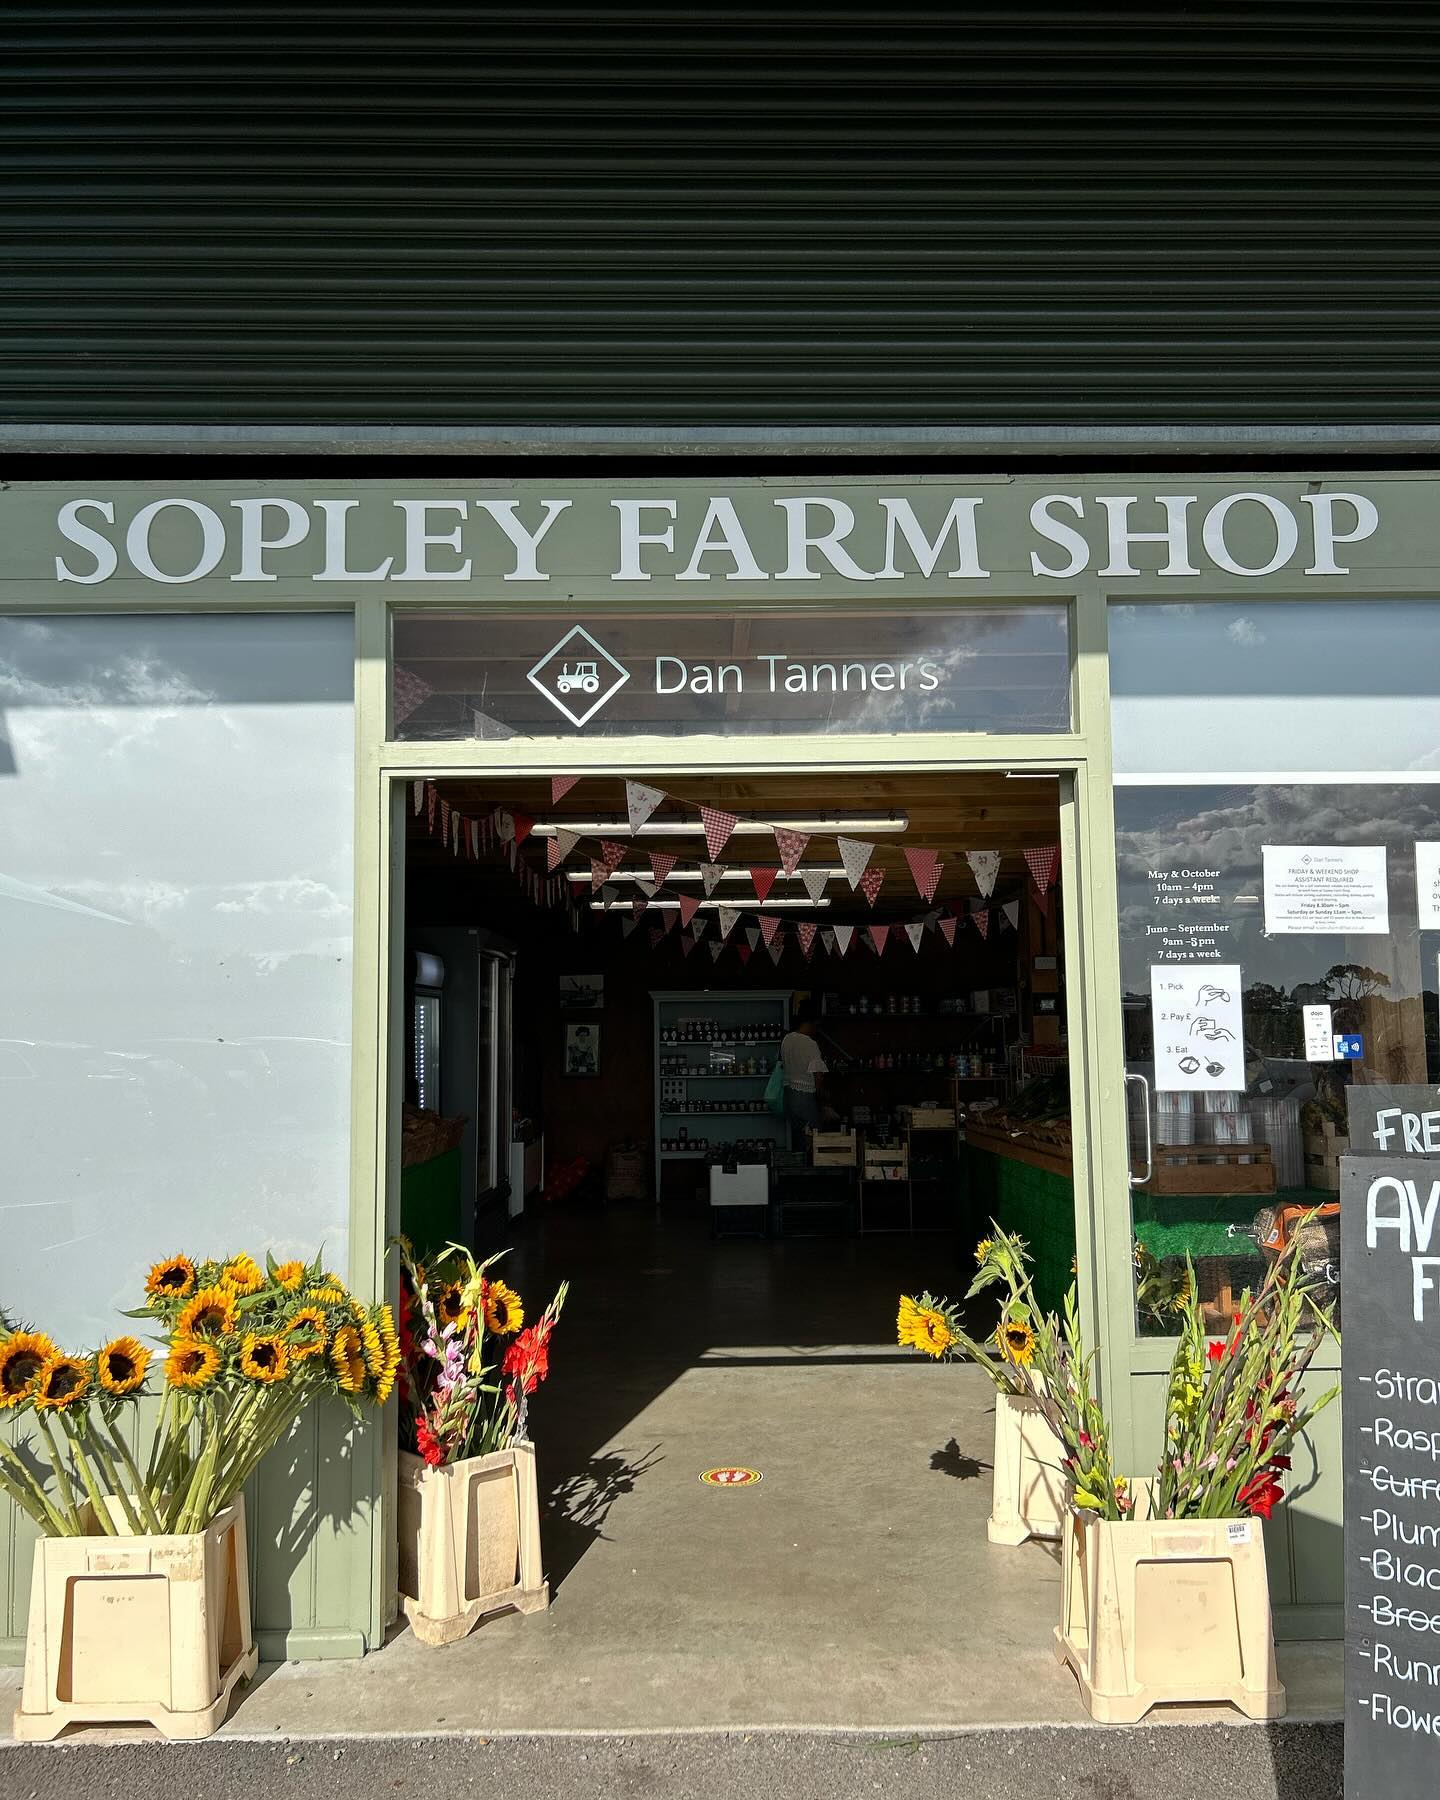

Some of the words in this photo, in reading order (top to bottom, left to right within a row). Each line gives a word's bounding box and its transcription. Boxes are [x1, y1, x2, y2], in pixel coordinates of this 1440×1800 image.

[55, 497, 573, 584] SOPLEY
[610, 496, 991, 582] FARM
[1029, 492, 1380, 579] SHOP
[655, 655, 743, 694] Dan
[757, 655, 939, 693] Tanner's
[1148, 870, 1168, 880] May
[1171, 870, 1180, 878] &
[1181, 869, 1220, 878] October
[1156, 883, 1182, 892] 10am
[1192, 882, 1214, 892] 4pm
[1154, 896, 1160, 904] 7
[1162, 896, 1183, 906] days
[1192, 895, 1217, 904] week
[1145, 925, 1168, 936] June
[1178, 923, 1230, 934] September
[1162, 937, 1183, 946] 9am
[1158, 950, 1164, 959] 7
[1166, 950, 1187, 961] days
[1197, 949, 1221, 958] week
[1170, 1013, 1184, 1022] Pay
[1366, 1176, 1440, 1252] AV
[1411, 1256, 1440, 1321] F
[1358, 1368, 1440, 1405] -Stra
